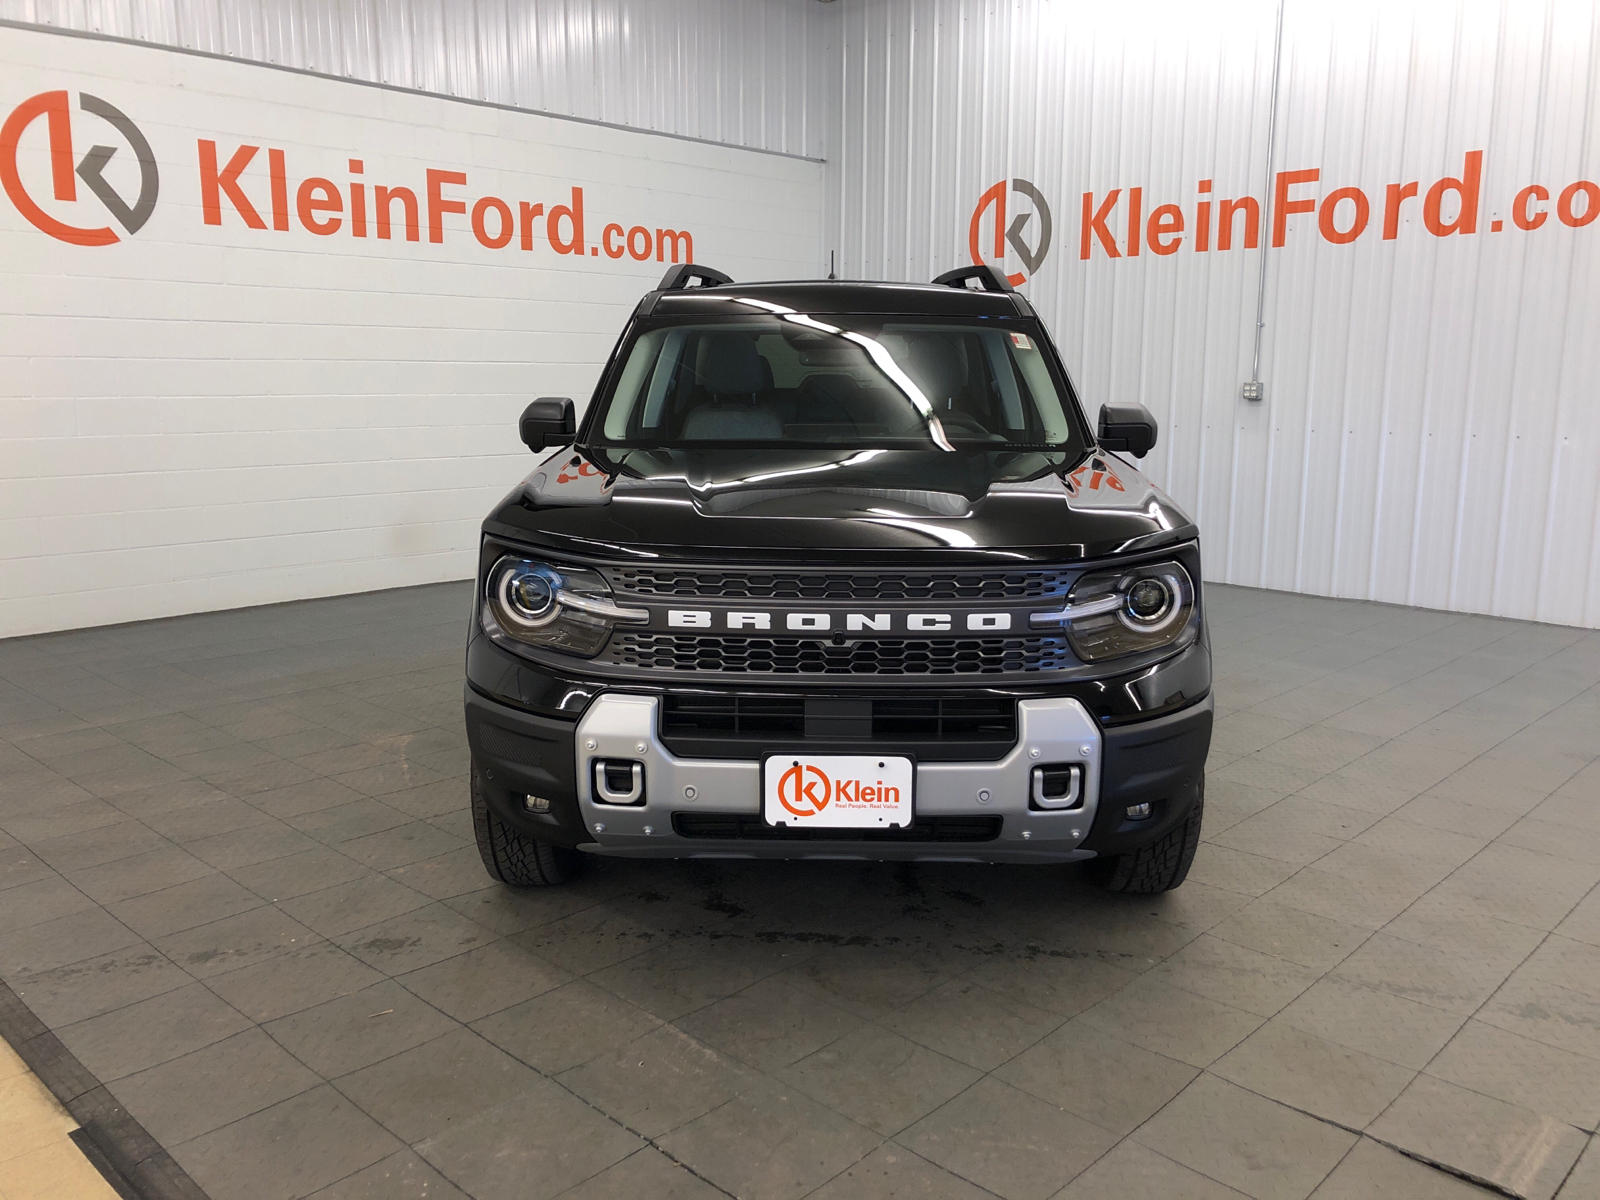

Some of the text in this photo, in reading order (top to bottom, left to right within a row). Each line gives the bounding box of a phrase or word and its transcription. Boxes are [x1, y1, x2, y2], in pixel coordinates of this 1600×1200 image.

[197, 138, 693, 264] KleinFord.com
[1080, 150, 1600, 260] KleinFord.co
[667, 609, 1012, 632] BRONCO
[835, 780, 900, 803] Klein
